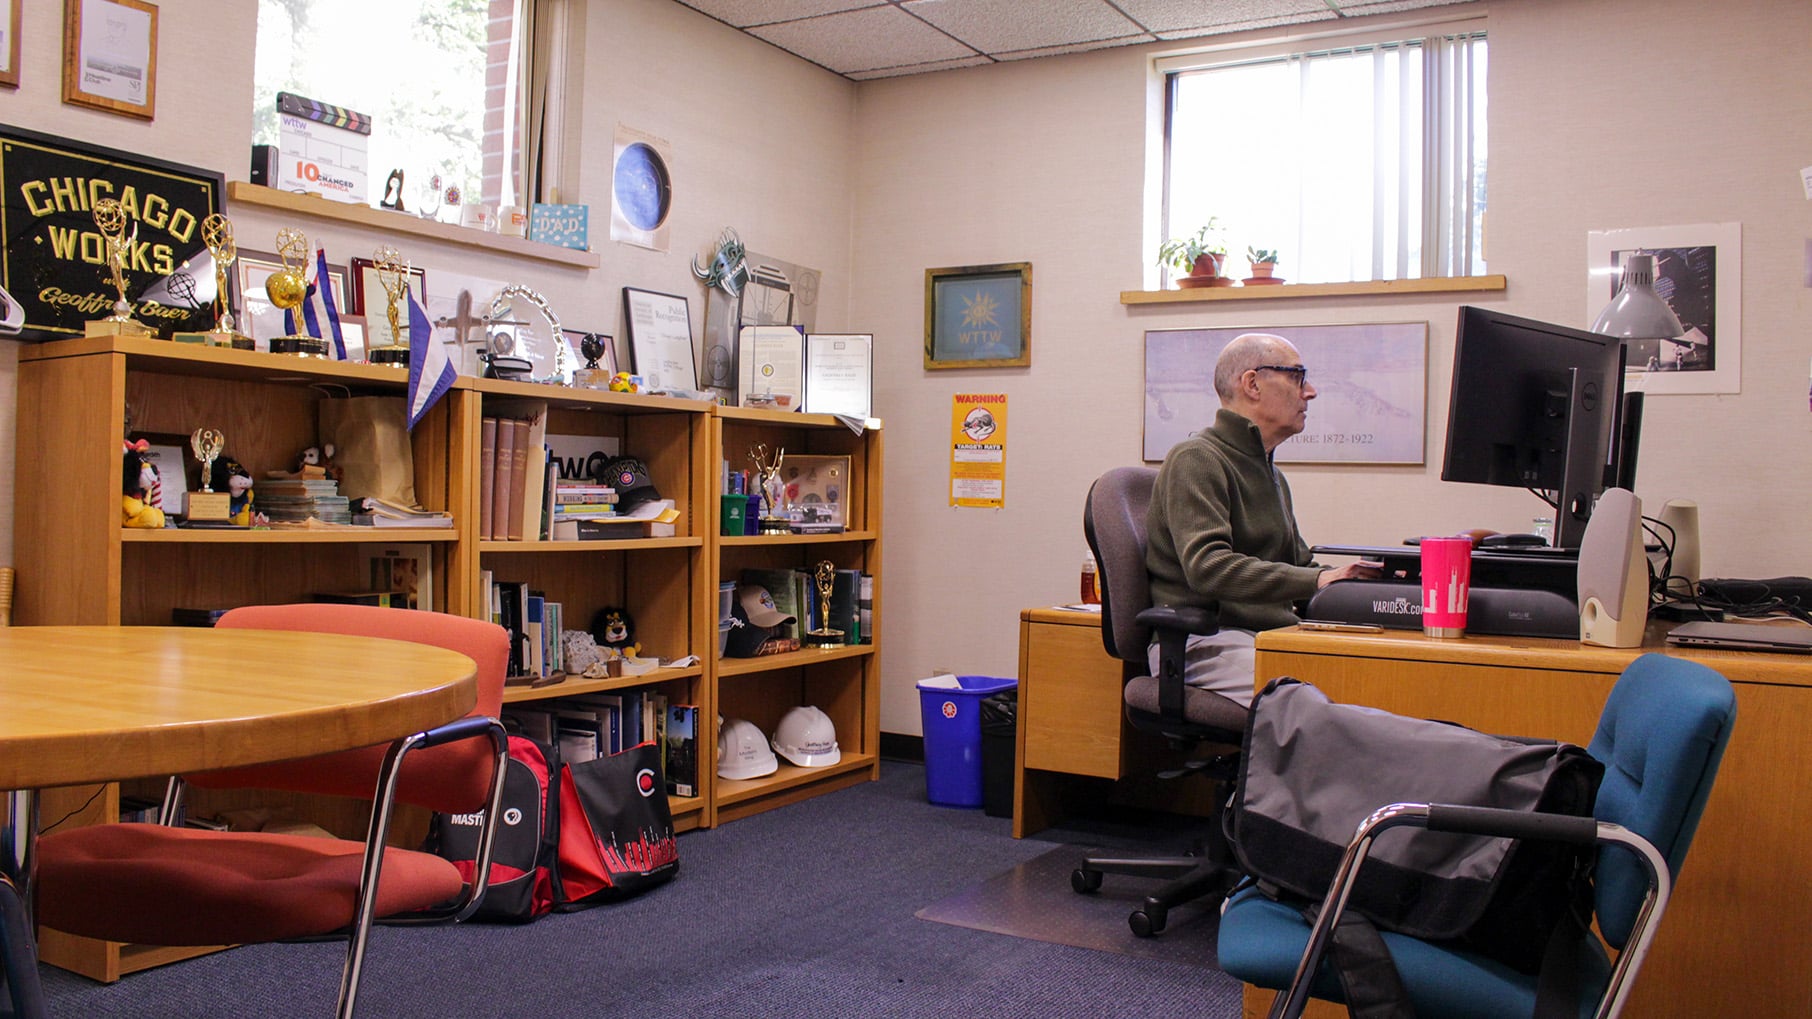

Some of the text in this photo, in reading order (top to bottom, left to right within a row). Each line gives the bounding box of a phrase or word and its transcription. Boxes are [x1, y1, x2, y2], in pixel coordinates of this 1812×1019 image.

[539, 217, 580, 233] DAD
[139, 299, 192, 321] Baer
[959, 331, 1002, 345] WTTW
[955, 394, 1007, 404] WARNING
[1323, 433, 1374, 444] 1872-1922
